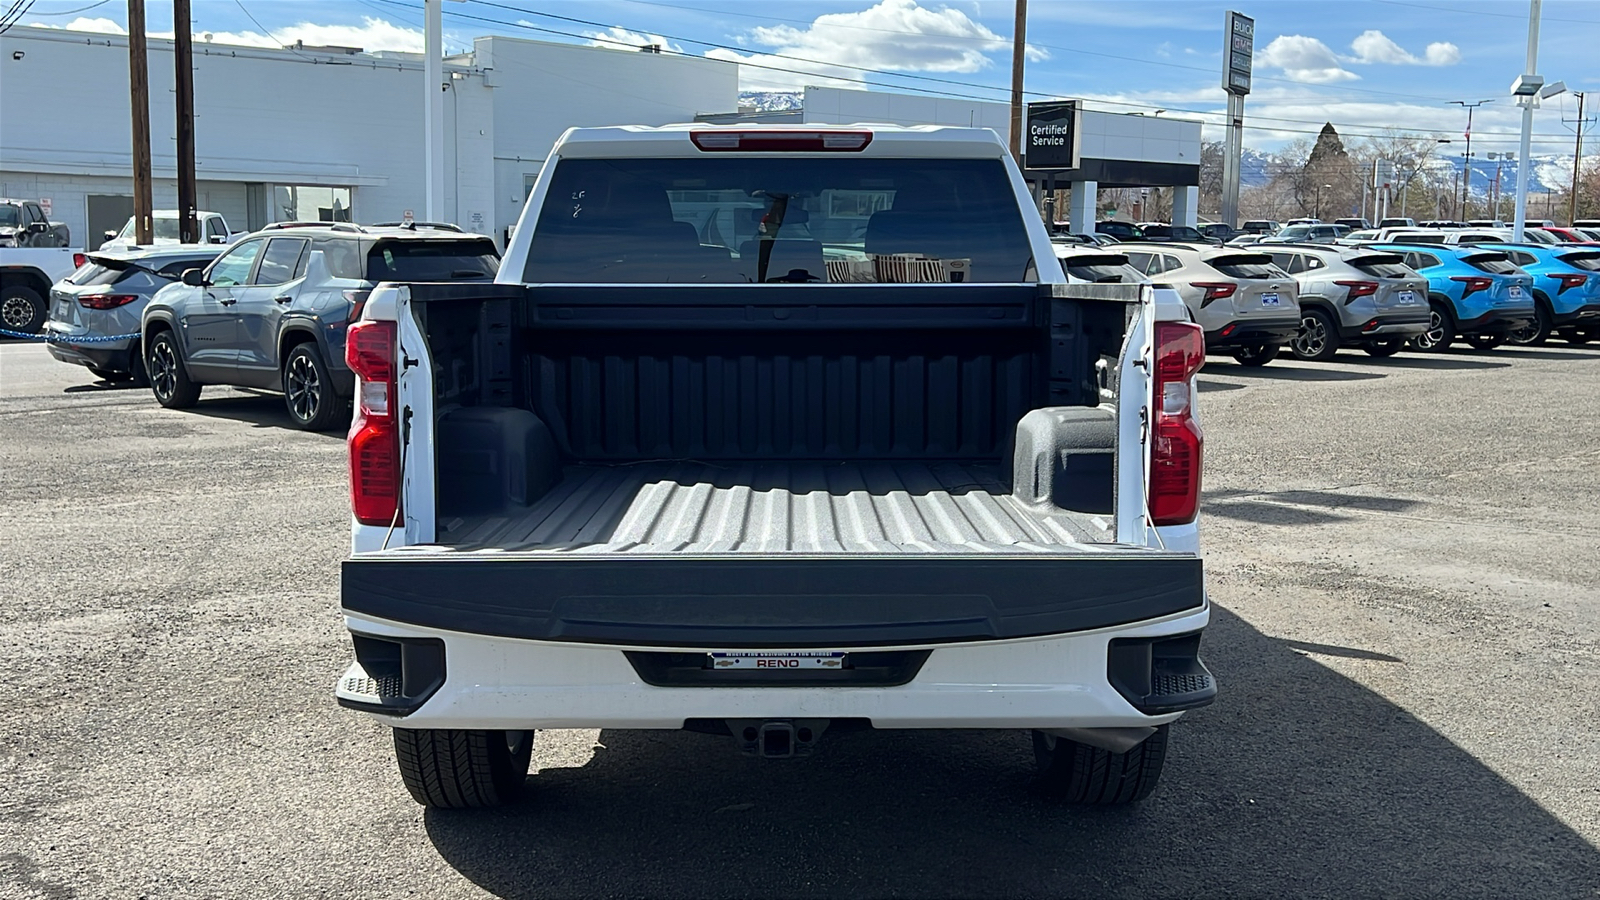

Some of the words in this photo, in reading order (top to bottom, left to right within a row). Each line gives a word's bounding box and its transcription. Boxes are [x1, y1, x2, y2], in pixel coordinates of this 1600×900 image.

[1234, 20, 1254, 36] BUICK
[1235, 37, 1252, 51] GMC
[1031, 124, 1067, 135] Certified
[1032, 135, 1064, 145] Service
[756, 659, 800, 668] RENO
